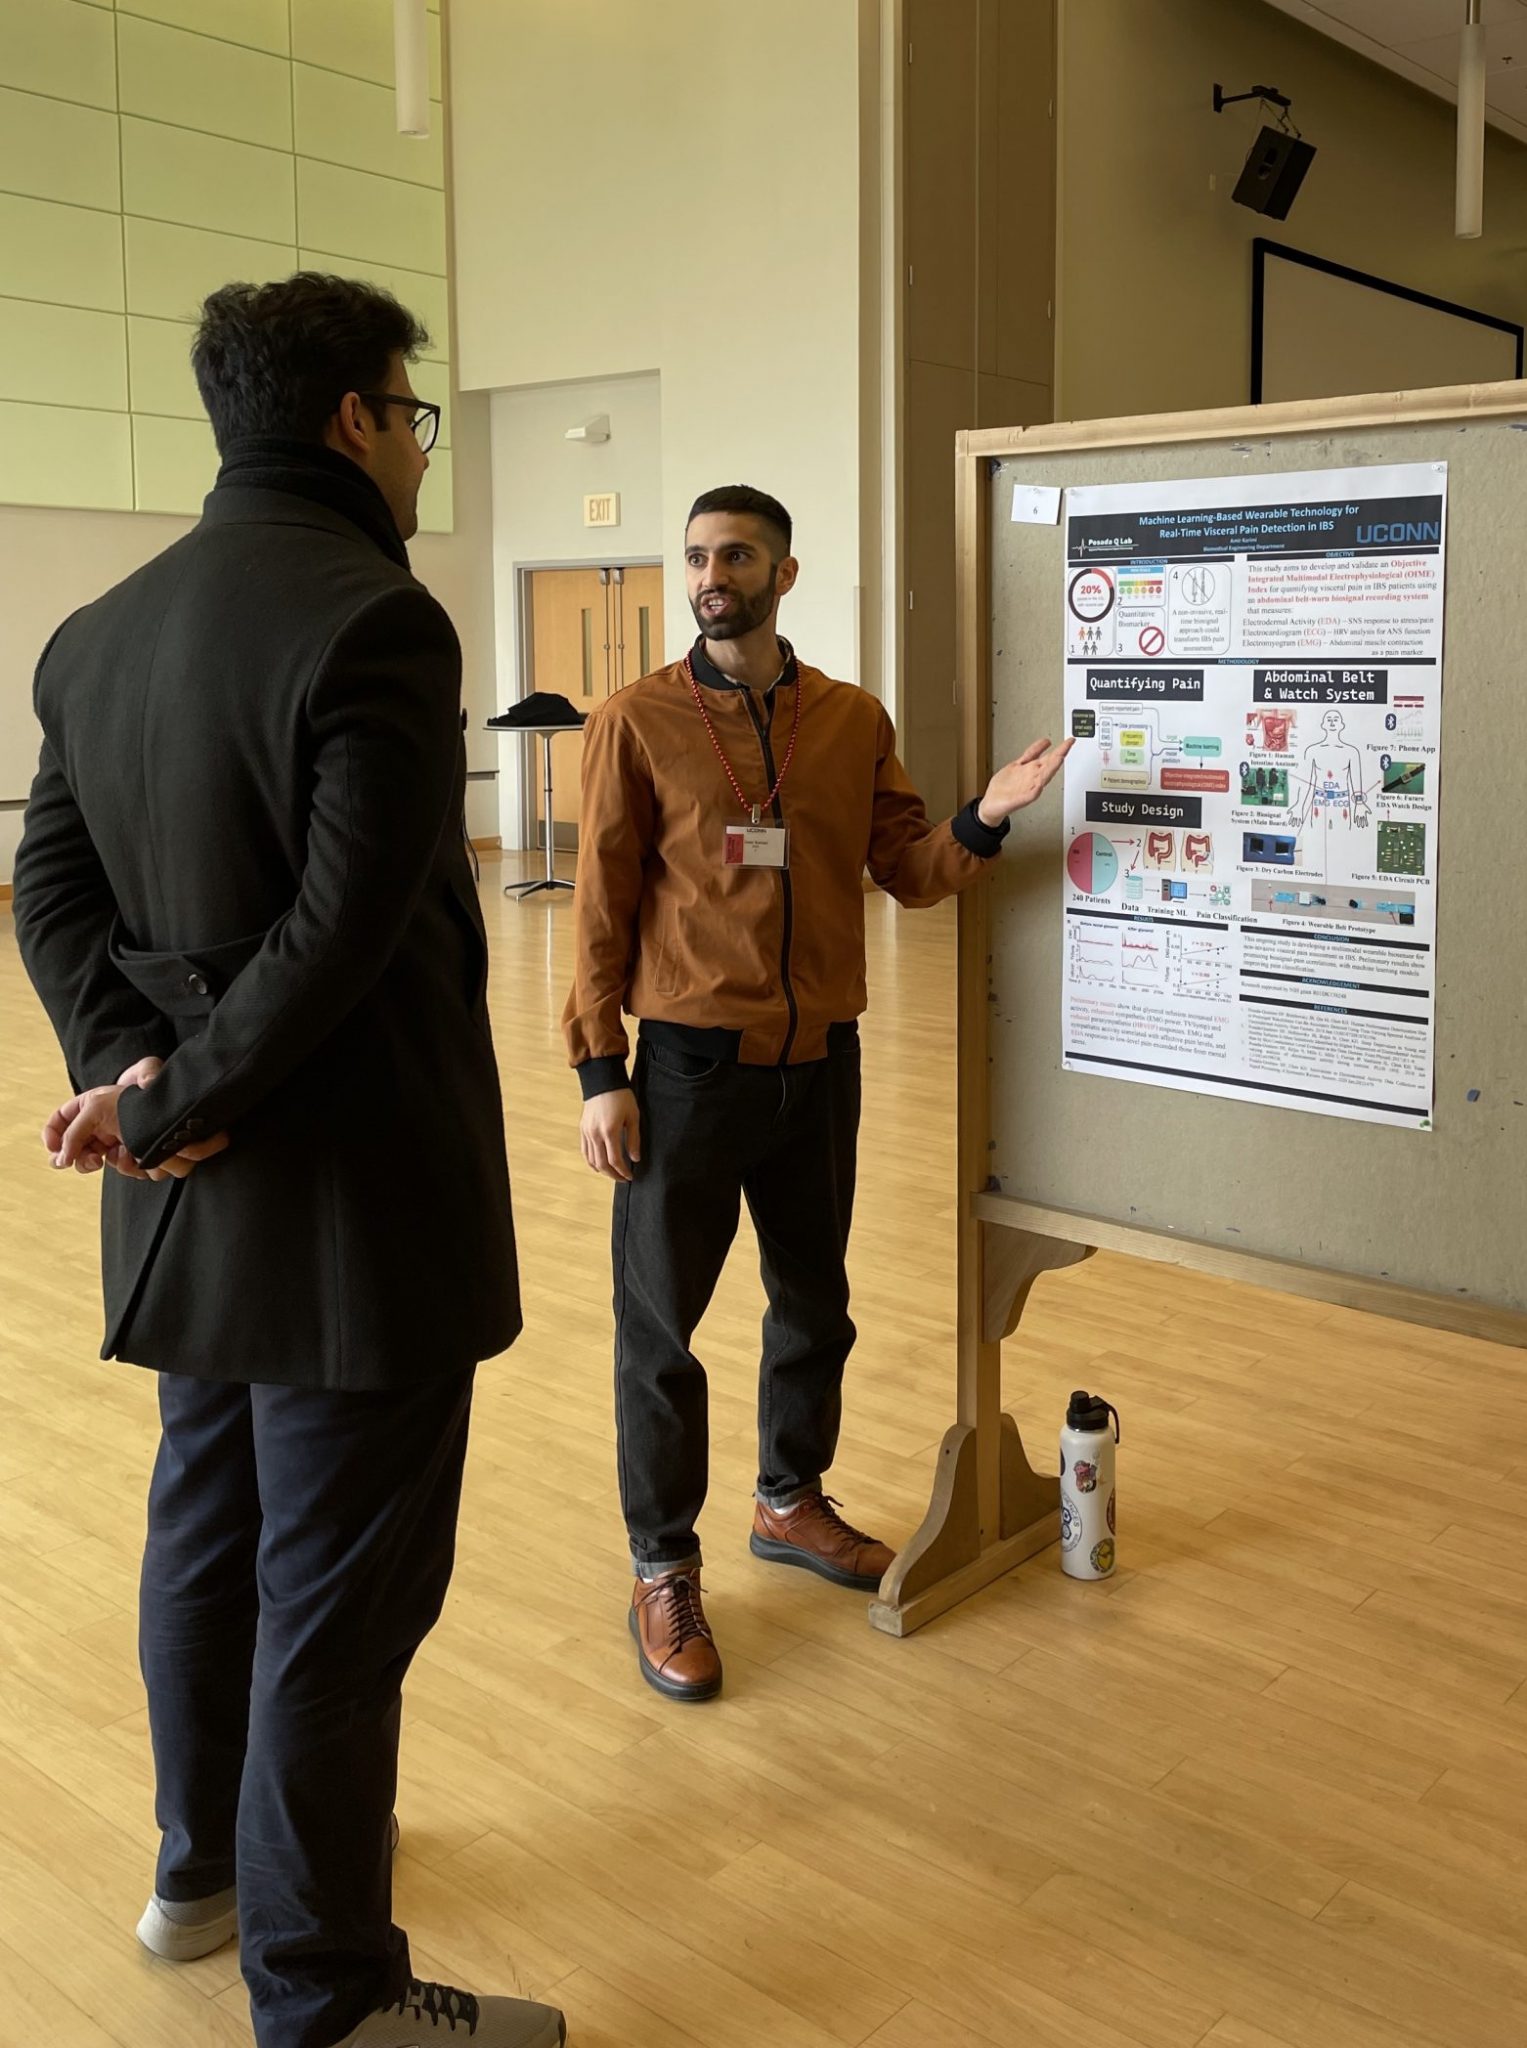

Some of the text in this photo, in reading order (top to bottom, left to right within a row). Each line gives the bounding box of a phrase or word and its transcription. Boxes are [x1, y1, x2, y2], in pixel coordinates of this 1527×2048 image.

[589, 498, 611, 522] EXIT
[1139, 504, 1360, 526] Machine Learning-Based Wearable Technology for
[1160, 521, 1335, 539] Real-Time Visceral Pain Detection in IBS
[1356, 521, 1440, 544] UCONN
[1113, 538, 1120, 547] Q
[1120, 537, 1133, 545] Lab
[1248, 564, 1263, 573] This
[1264, 564, 1281, 574] study
[1309, 563, 1336, 572] develop
[1336, 562, 1350, 570] and
[1351, 561, 1378, 569] validate
[1390, 560, 1427, 569] Objective
[1173, 571, 1178, 580] 4
[1248, 575, 1284, 584] Integrated
[1286, 573, 1328, 582] Multimodal
[1080, 585, 1102, 594] 20%
[1269, 585, 1279, 593] for
[1280, 584, 1318, 594] quantifying
[1320, 584, 1346, 592] visceral
[1348, 584, 1363, 593] pain
[1373, 582, 1387, 590] IBS
[1388, 582, 1417, 591] patients
[1417, 582, 1437, 591] using
[1117, 597, 1123, 606] 2
[1257, 596, 1294, 604] abdominal
[1295, 595, 1330, 603] belt-worn
[1331, 594, 1364, 603] biosignal
[1365, 593, 1401, 602] recording
[1403, 593, 1429, 602] system
[1118, 610, 1156, 618] Quantitative
[1118, 620, 1150, 628] Biomarker
[1242, 617, 1289, 627] Electrodermal
[1289, 618, 1316, 628] Activity
[1317, 617, 1341, 626] (EDA)
[1242, 628, 1302, 638] Electrocardiogram
[1303, 628, 1327, 637] (ECG)
[1349, 628, 1376, 637] analysis
[1071, 645, 1075, 653] 1
[1118, 643, 1123, 652] 3
[1242, 639, 1296, 649] Electromyogram
[1297, 638, 1322, 648] (EMG)
[1329, 639, 1363, 647] Abdominal
[1264, 671, 1375, 683] Abdominal Belt
[1090, 676, 1201, 692] Quantifying Pain
[1263, 688, 1375, 703] & Watch System
[1366, 743, 1436, 754] Figure 7: Phone App
[1375, 793, 1396, 801] Figure
[1314, 799, 1350, 808] EMG ECG
[1375, 801, 1432, 811] EDA Watch Design
[1101, 801, 1185, 819] Study Design
[1231, 809, 1250, 818] Figure
[1071, 826, 1075, 835] 1
[1136, 838, 1142, 848] 2
[1124, 869, 1130, 878] 3
[1236, 865, 1323, 878] Figure Dry Carbon Electrodes
[1351, 873, 1372, 881] Figure
[1394, 876, 1415, 884] Circuit
[1415, 877, 1430, 885] PCB
[1072, 894, 1112, 905] 240 Patients
[1121, 902, 1258, 924] Data Training ML Pain Classification
[1282, 918, 1301, 926] Figure
[1308, 920, 1335, 930] Wearable
[1347, 924, 1376, 934] Prototype
[1313, 933, 1350, 943] CONCLUSION
[1313, 1004, 1348, 1014] REFERENCES
